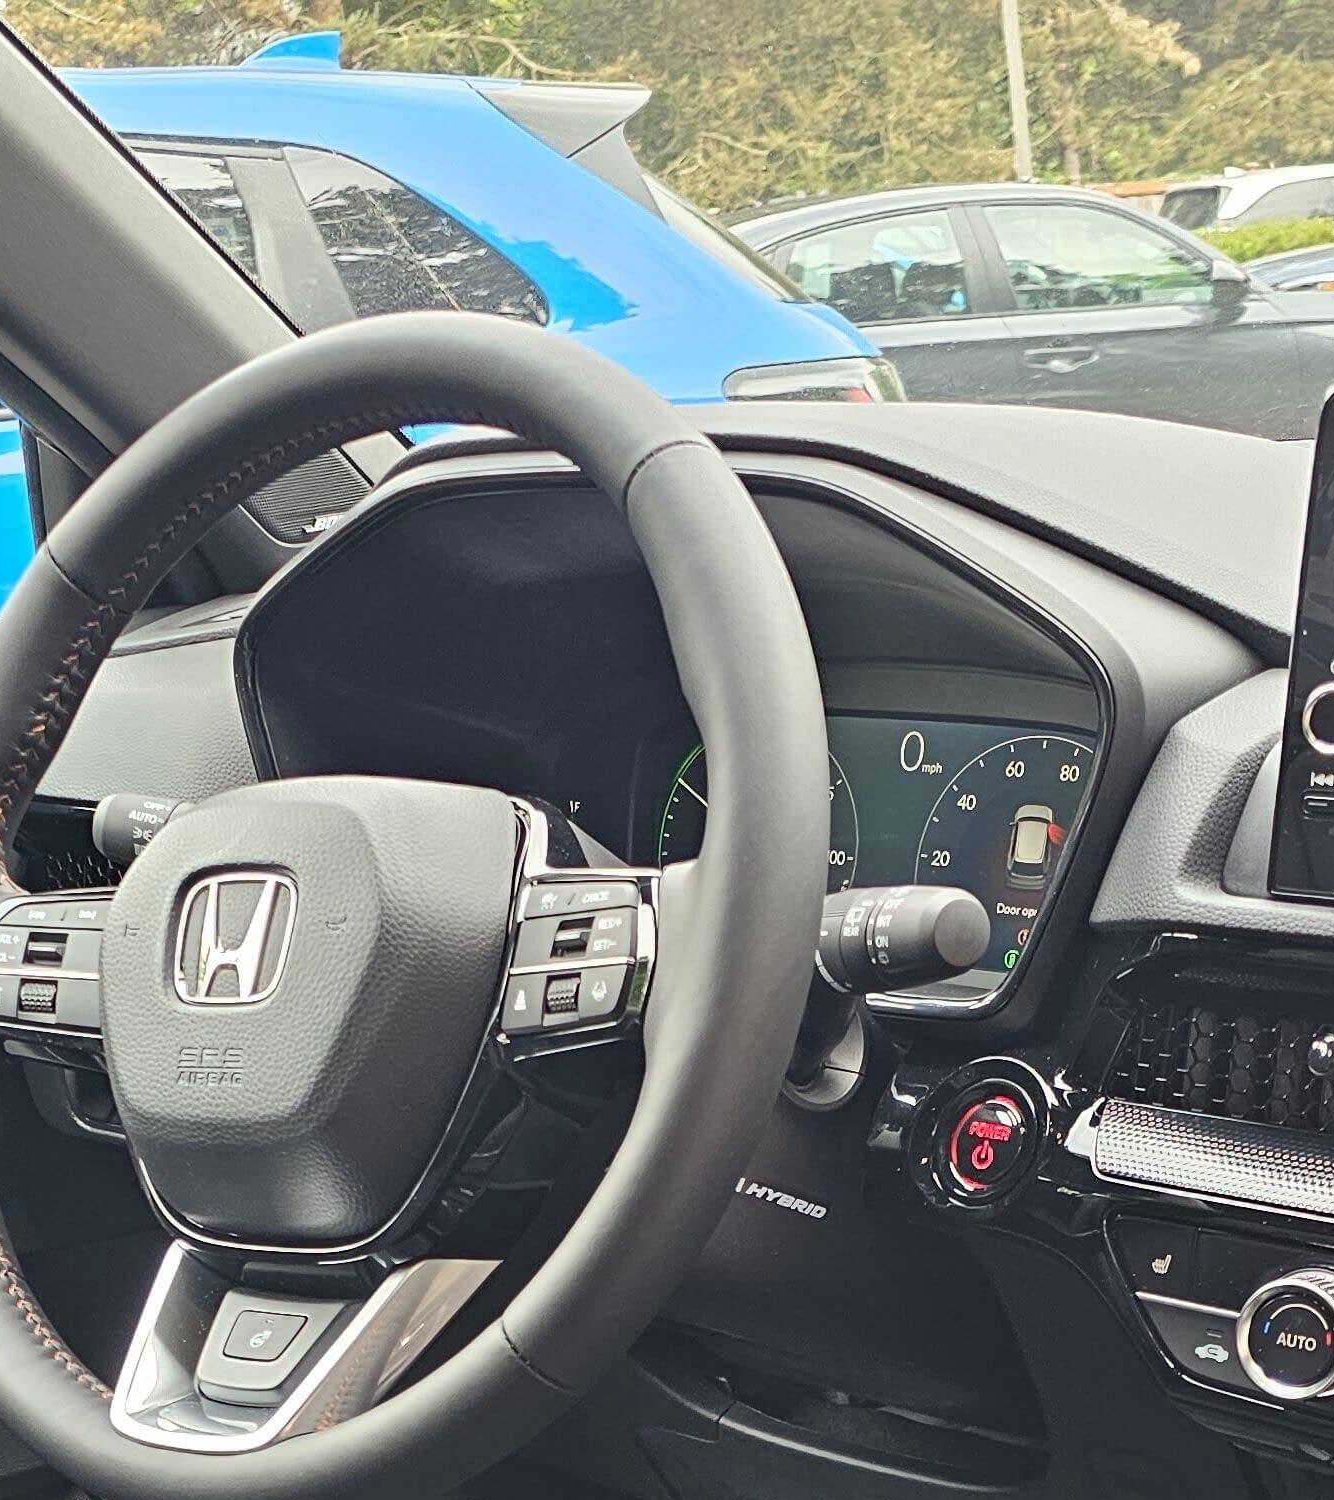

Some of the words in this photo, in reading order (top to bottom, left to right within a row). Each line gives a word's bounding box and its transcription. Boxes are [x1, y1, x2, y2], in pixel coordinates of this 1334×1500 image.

[900, 730, 925, 772] 0
[921, 763, 943, 775] mph
[1005, 760, 1025, 778] 60
[1059, 764, 1080, 782] 80
[956, 793, 977, 811] 40
[128, 810, 158, 825] AUTO
[931, 850, 951, 867] 20
[996, 902, 1021, 917] Door
[1021, 906, 1038, 919] op
[843, 926, 860, 937] REAR
[875, 935, 889, 948] ON
[177, 1046, 244, 1066] SRS
[745, 1182, 827, 1219] HYBRID
[1275, 1331, 1317, 1352] AUTO
